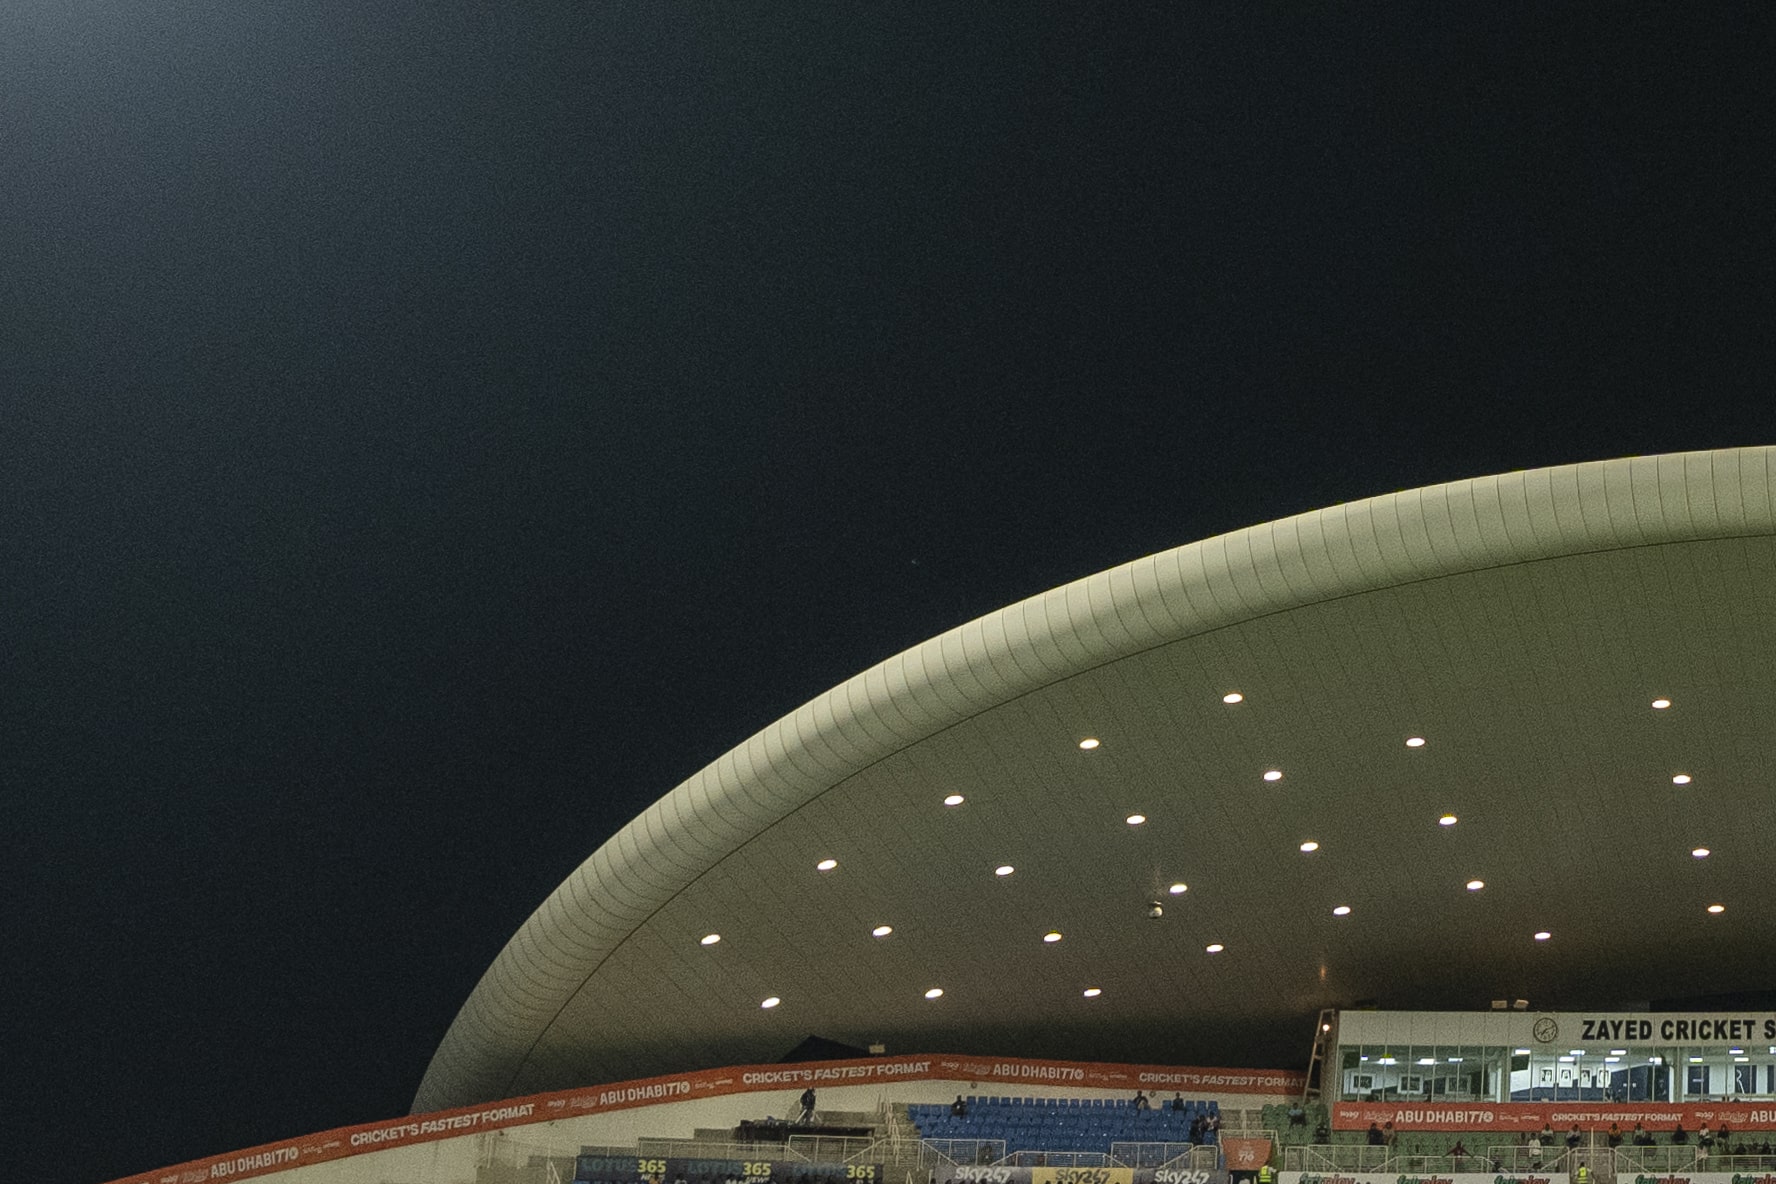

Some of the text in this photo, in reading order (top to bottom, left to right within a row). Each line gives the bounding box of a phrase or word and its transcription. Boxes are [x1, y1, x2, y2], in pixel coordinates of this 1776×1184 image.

[1582, 1020, 1652, 1040] ZAYED
[1661, 1019, 1755, 1040] CRICKET
[743, 1062, 931, 1085] CRICKET'S FASTEST FORMAT
[993, 1064, 1019, 1077] ABU
[1139, 1072, 1307, 1087] CRICKET'S FASTEST FORMAT
[600, 1090, 625, 1105] ABU
[1396, 1110, 1424, 1123] ABU
[1552, 1113, 1683, 1122] CRICKET'S FASTEST FORMAT
[351, 1104, 535, 1147] CRICKET'S FASTEST FORMAT
[211, 1161, 235, 1179] ABU
